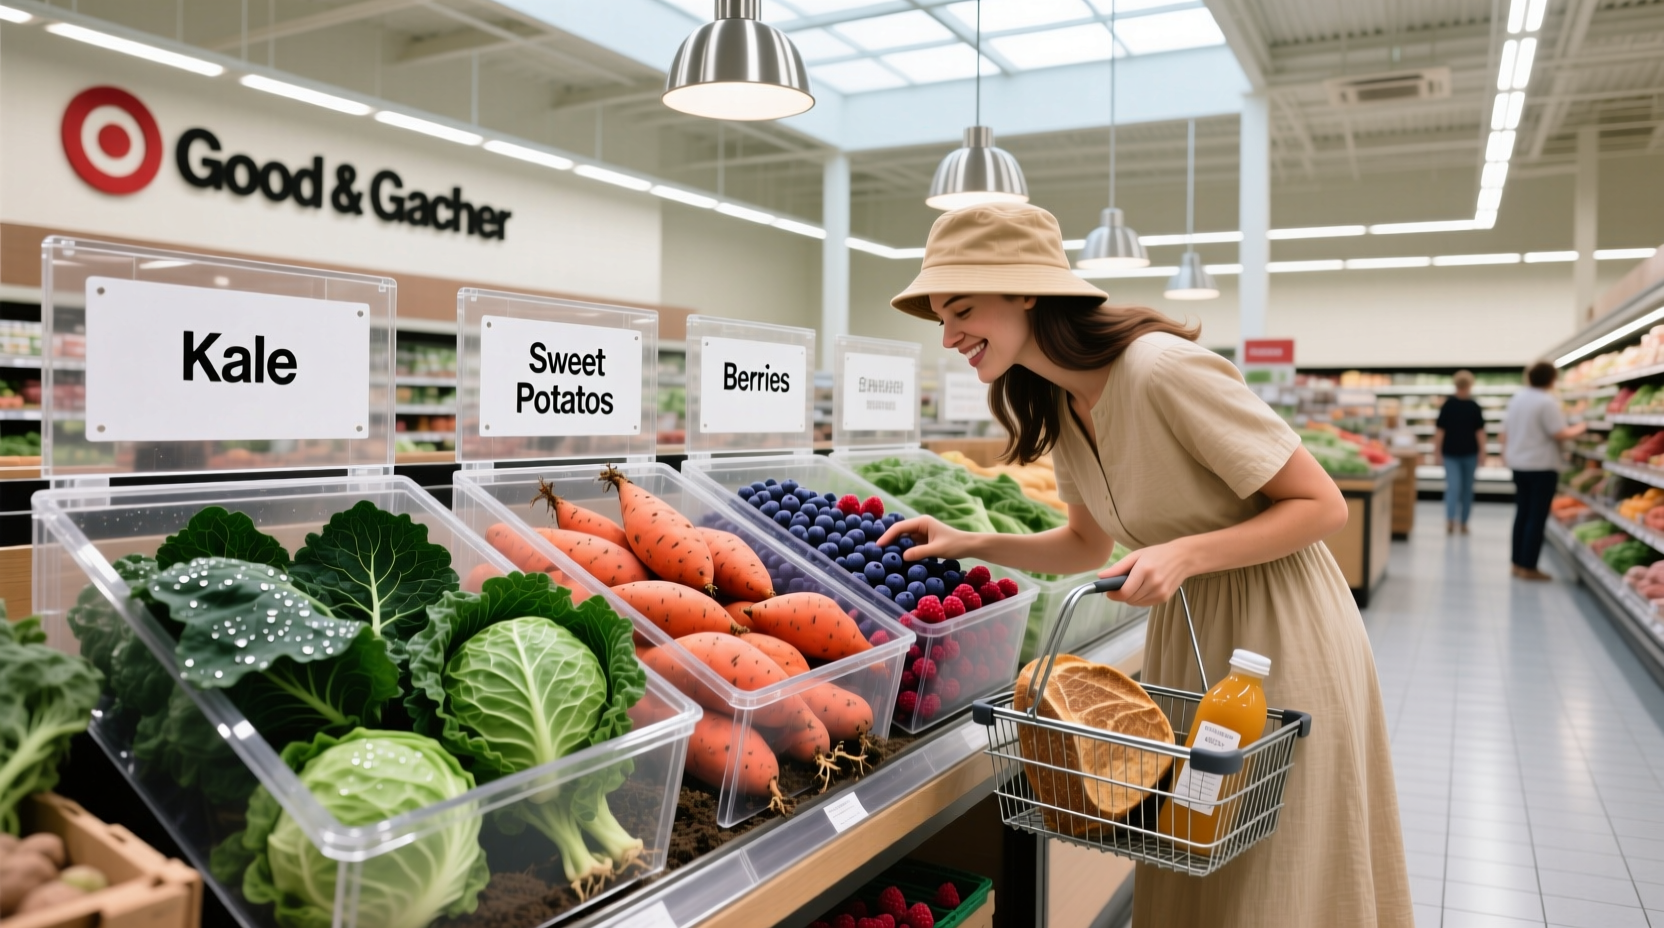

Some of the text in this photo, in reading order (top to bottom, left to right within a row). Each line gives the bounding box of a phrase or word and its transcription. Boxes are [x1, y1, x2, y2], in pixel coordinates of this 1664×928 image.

[175, 127, 513, 241] Good & Gacher
[182, 330, 299, 385] Kale
[528, 341, 607, 378] Sweet
[723, 361, 791, 394] Berries
[515, 381, 615, 416] Potatos
